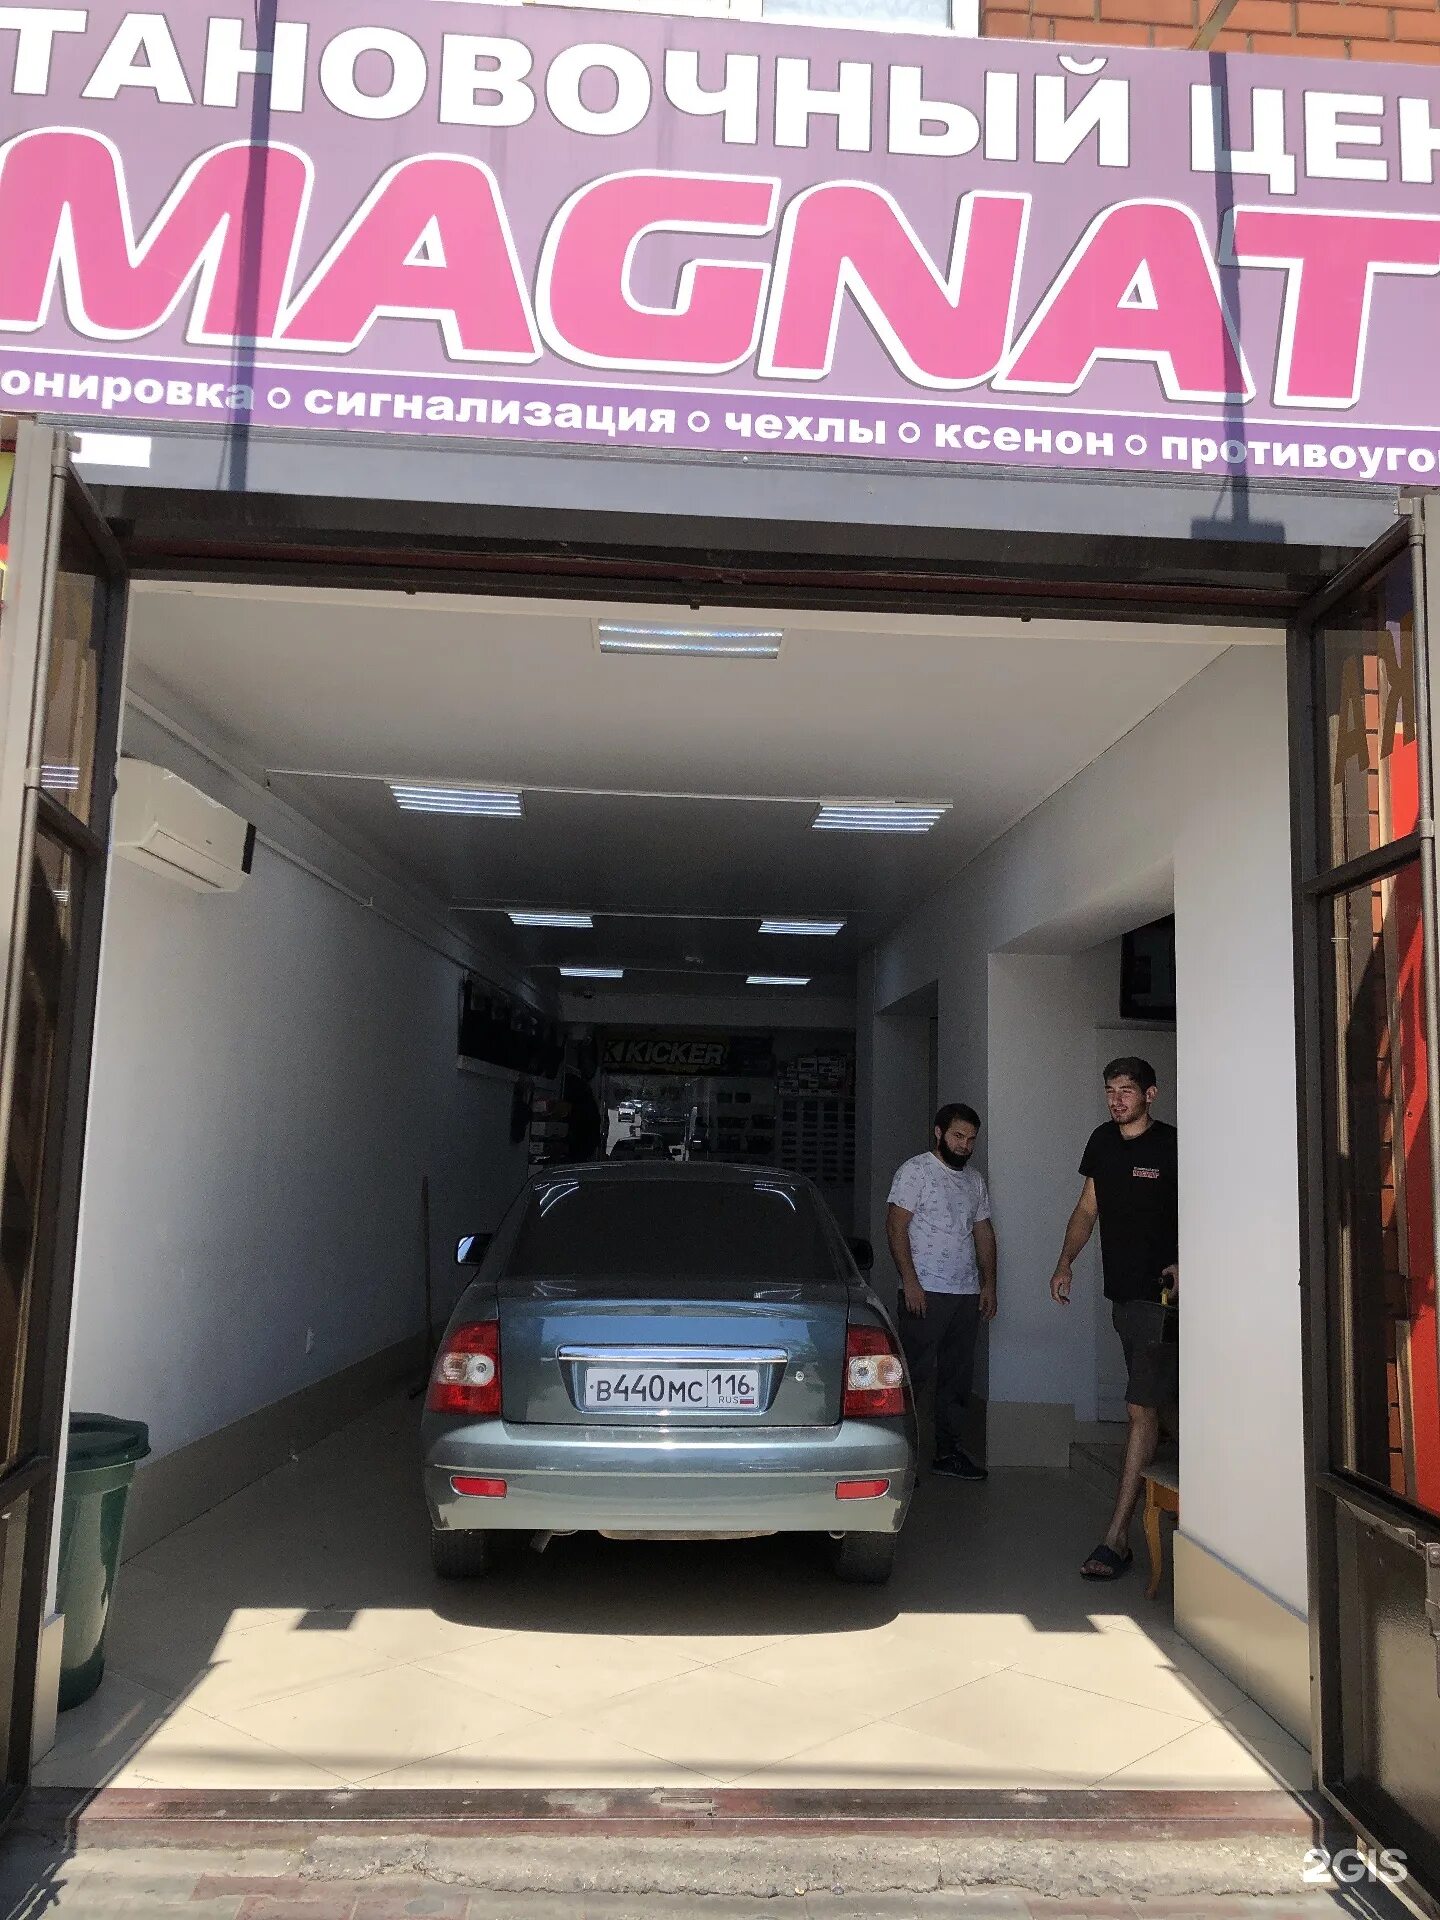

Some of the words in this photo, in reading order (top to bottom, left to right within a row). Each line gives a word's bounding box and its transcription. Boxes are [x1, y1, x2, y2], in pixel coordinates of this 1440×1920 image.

[0, 7, 1130, 167] ТАНОВОЧНЫЙ
[0, 126, 1440, 409] MAGNAT
[0, 371, 253, 411] онировка
[304, 388, 675, 435] сигнализация
[725, 411, 886, 446] чехлы
[935, 424, 1113, 457] ксенон
[624, 1041, 727, 1066] KICKER
[711, 1374, 750, 1396] 116
[718, 1396, 739, 1405] RUS
